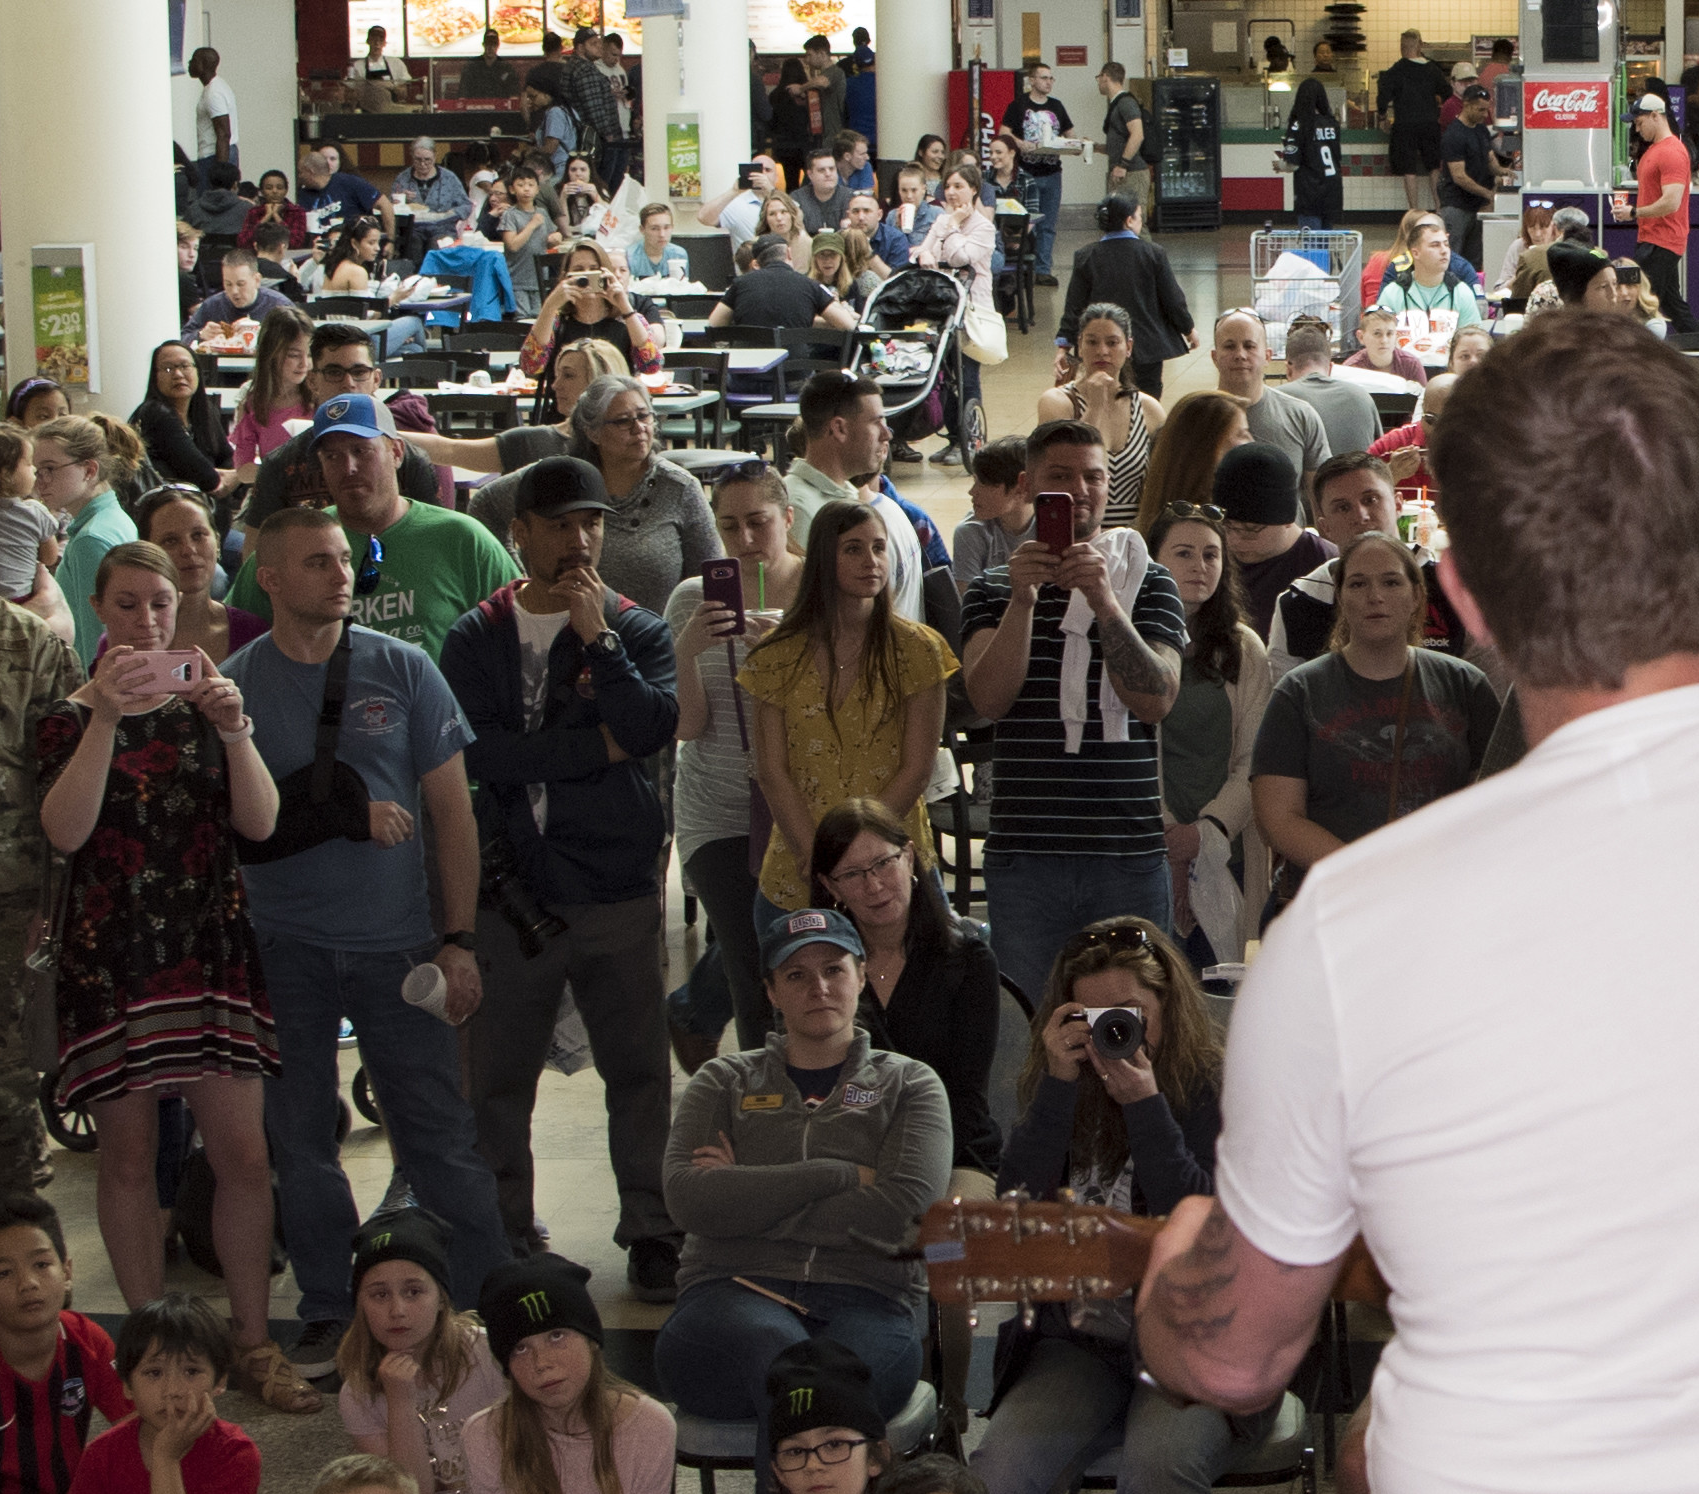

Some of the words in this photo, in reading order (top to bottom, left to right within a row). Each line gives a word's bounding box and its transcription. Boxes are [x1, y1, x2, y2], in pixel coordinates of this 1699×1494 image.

[1532, 89, 1601, 113] Coca-Cola
[1319, 145, 1337, 177] 9
[350, 590, 416, 627] RKEN
[797, 914, 821, 930] USO
